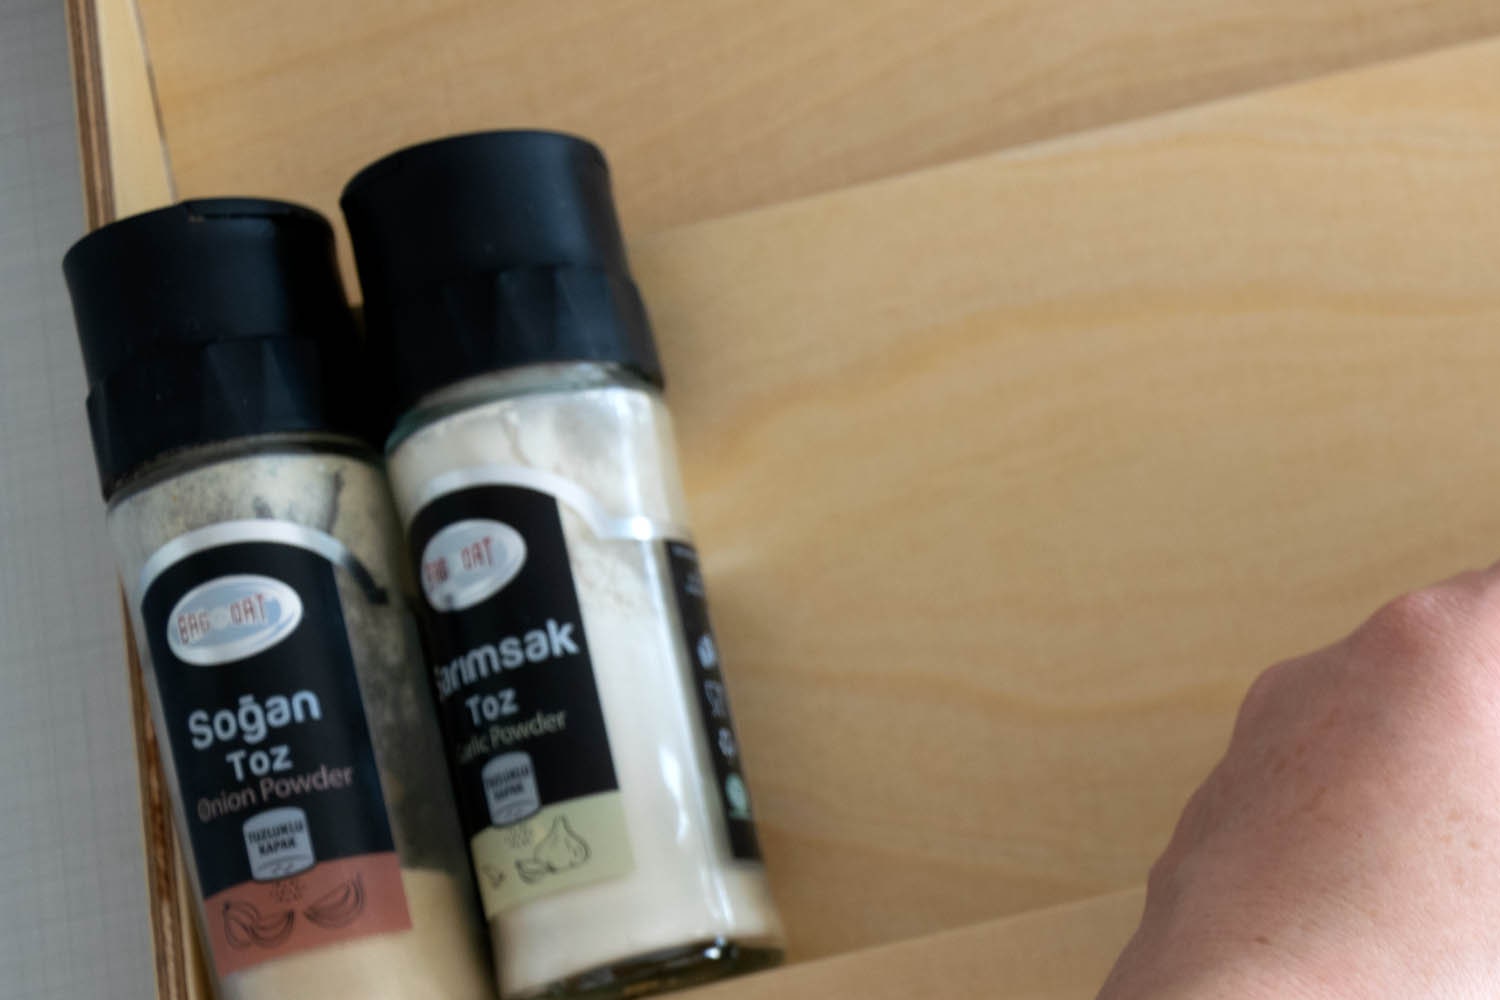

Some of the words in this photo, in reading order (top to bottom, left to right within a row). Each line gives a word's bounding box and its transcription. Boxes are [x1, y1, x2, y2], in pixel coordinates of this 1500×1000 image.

[436, 617, 581, 698] arımsak
[188, 689, 322, 750] Soğan
[488, 710, 567, 750] Powder
[198, 787, 257, 822] Onion
[259, 764, 354, 801] Powder
